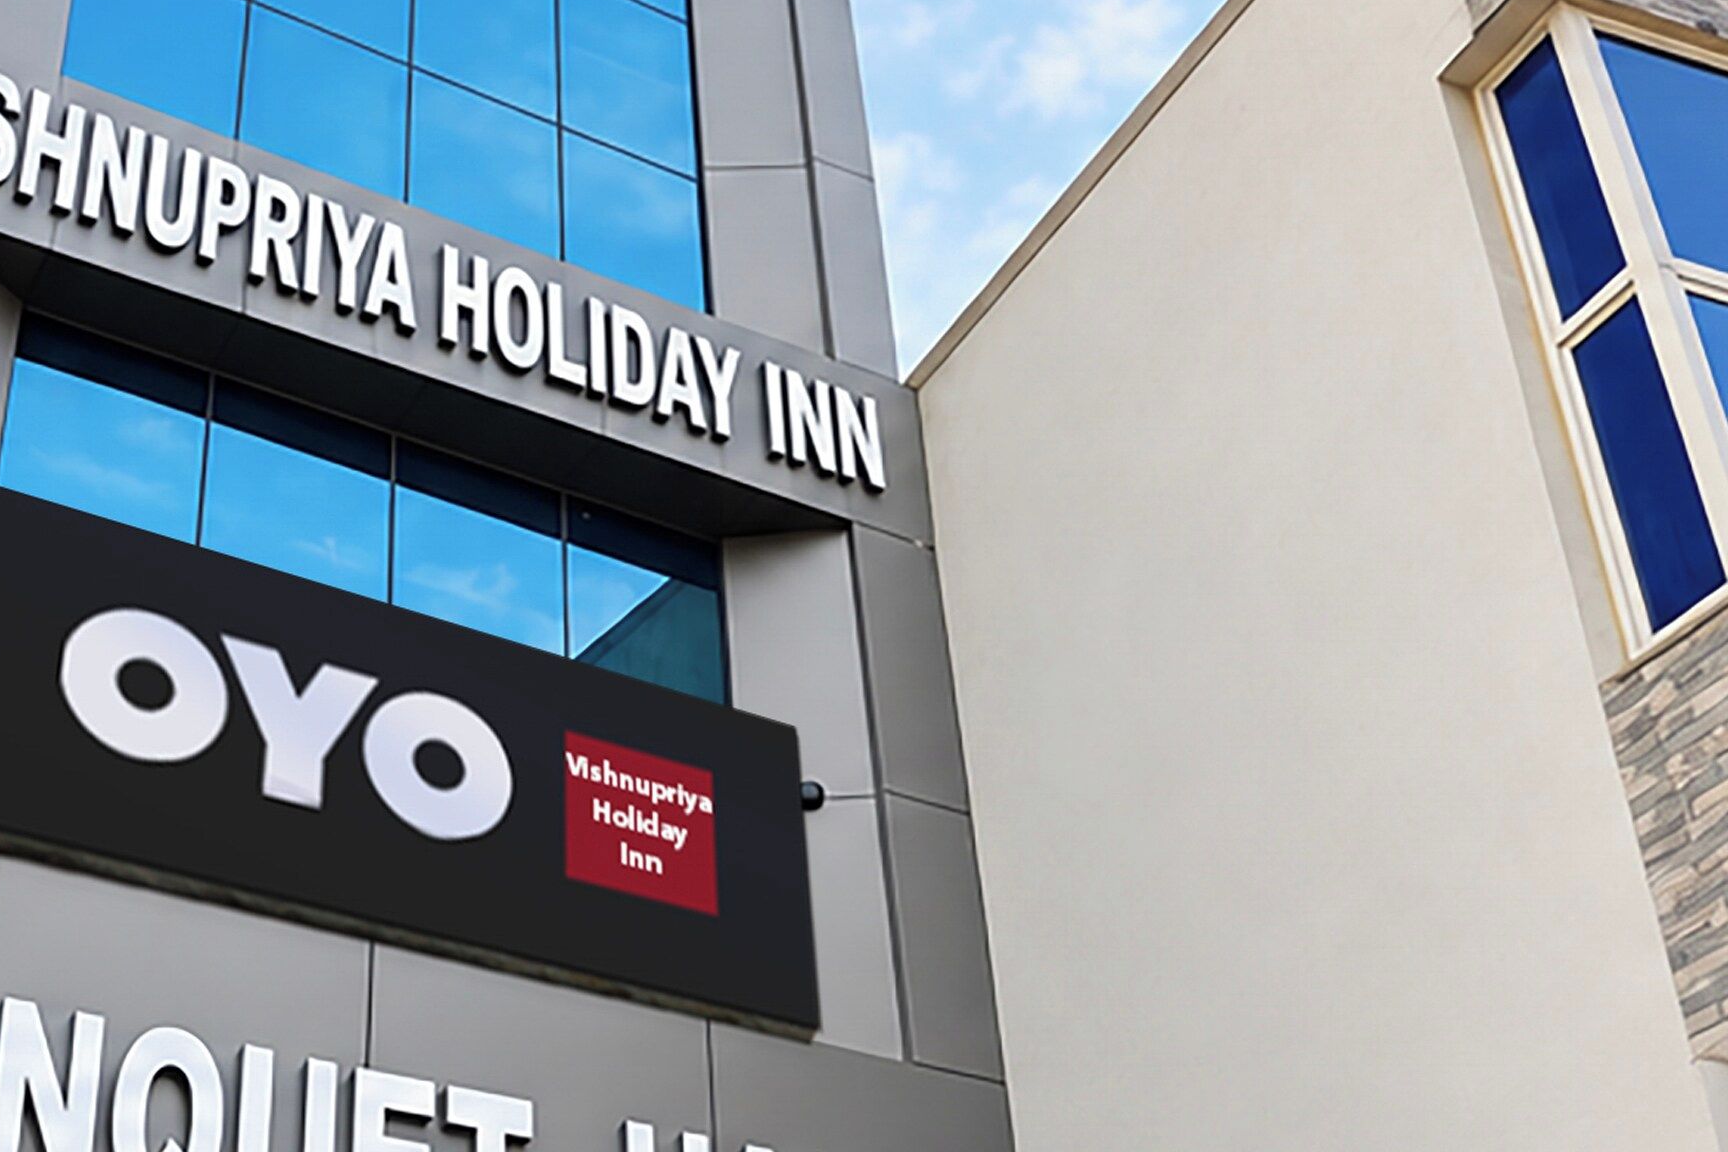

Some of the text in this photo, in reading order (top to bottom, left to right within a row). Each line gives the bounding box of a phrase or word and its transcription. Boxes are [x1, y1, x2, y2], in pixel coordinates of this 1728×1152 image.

[440, 242, 742, 438] HOLIDAY
[764, 359, 888, 490] INN
[59, 607, 513, 840] OYO
[565, 751, 714, 815] Vishnupriya
[592, 798, 688, 851] Holiday
[620, 841, 663, 875] Inn
